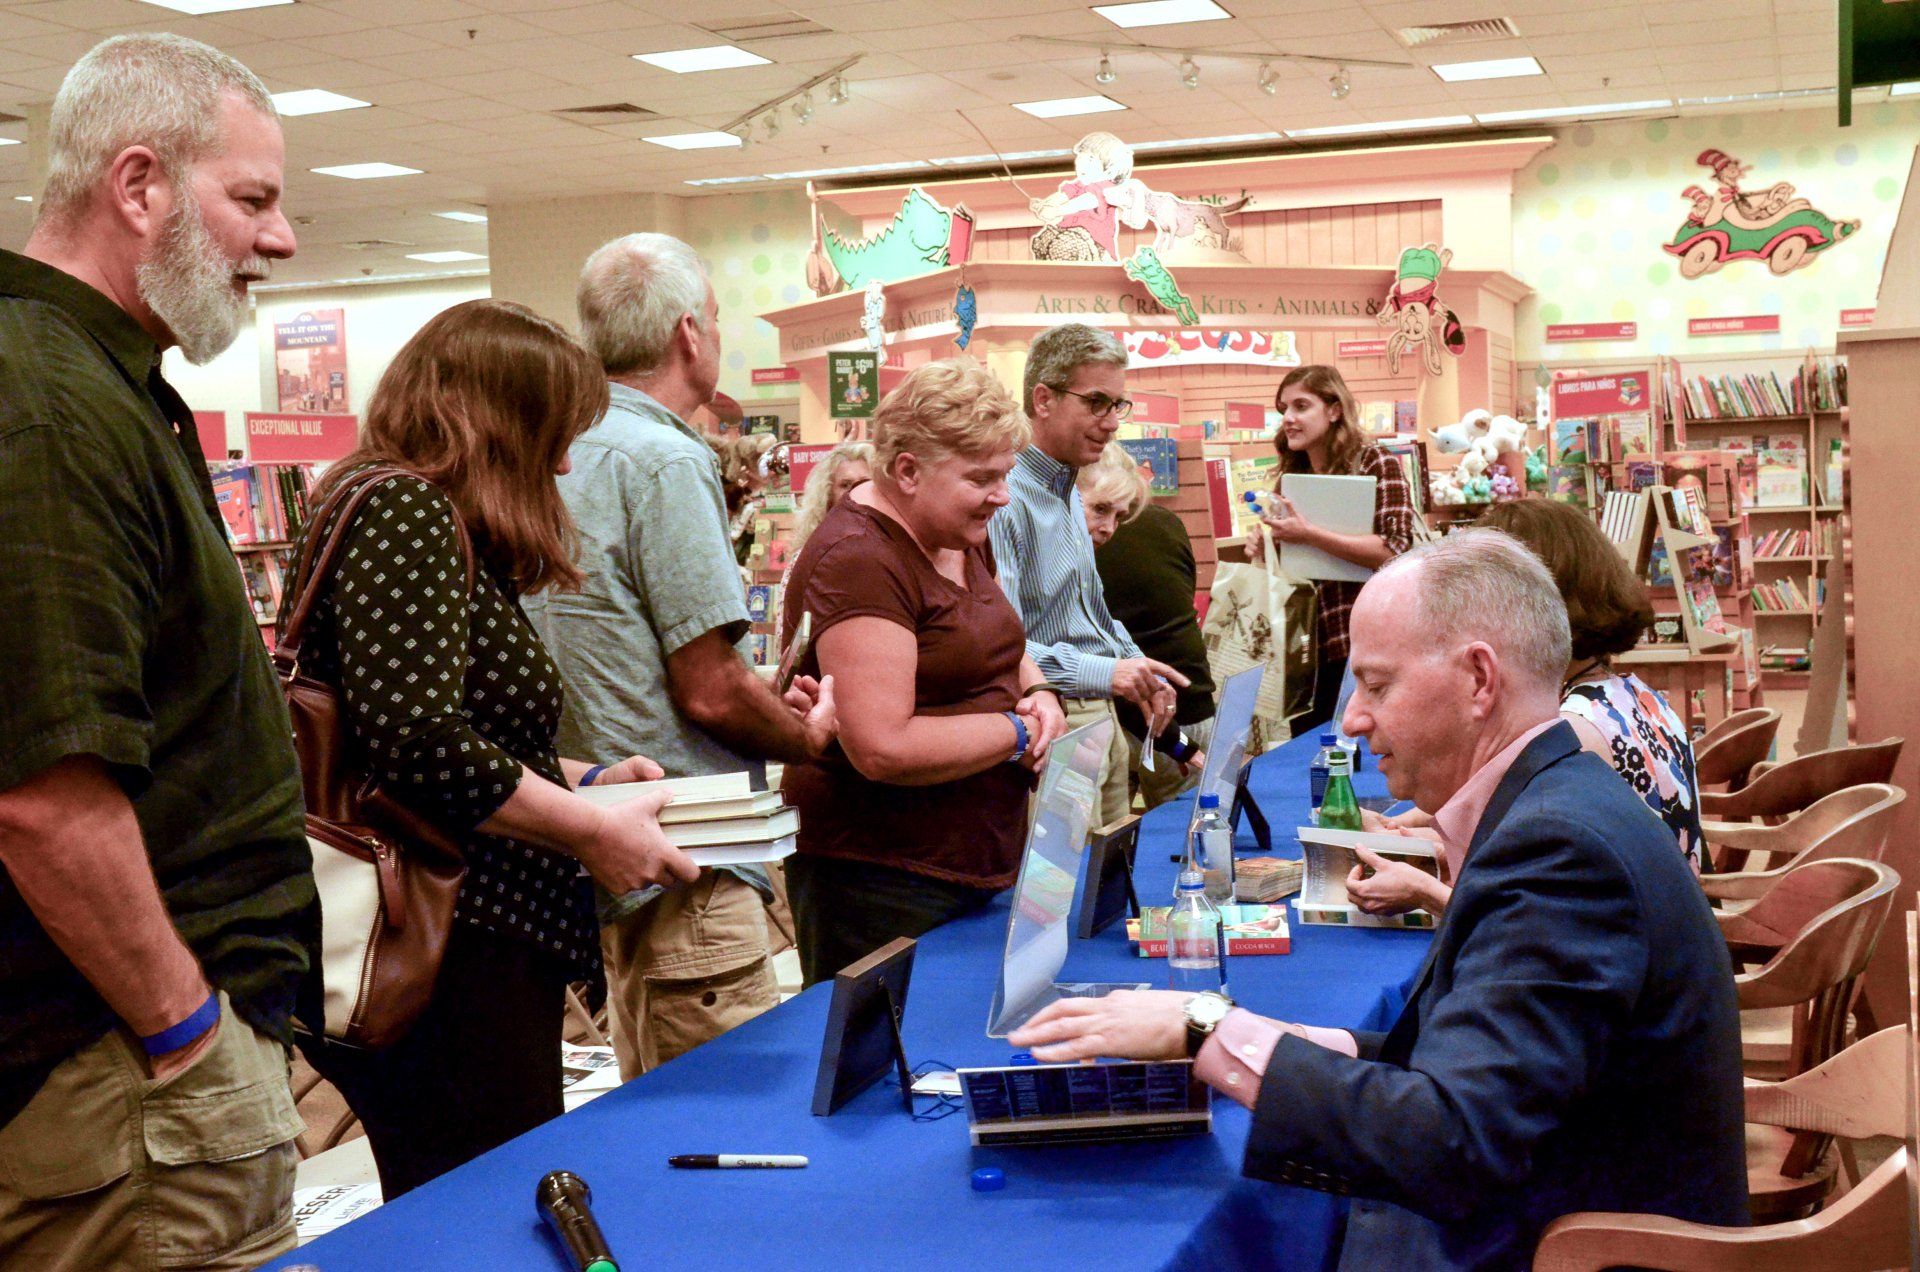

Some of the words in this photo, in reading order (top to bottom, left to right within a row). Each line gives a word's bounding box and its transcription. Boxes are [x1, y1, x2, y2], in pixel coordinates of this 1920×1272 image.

[1035, 293, 1087, 314] ARTS
[1092, 294, 1111, 314] &
[1118, 293, 1166, 315] CRA
[1201, 294, 1248, 316] KITS
[1273, 296, 1360, 316] ANIMALS
[907, 307, 947, 328] NATURE
[278, 327, 298, 335] TELL
[320, 324, 336, 332] THE
[287, 336, 328, 345] MOUNTAIN
[1558, 382, 1580, 394] LIBROS
[1580, 381, 1597, 391] PARA
[250, 419, 300, 435] EXCEPTIONAL
[300, 420, 323, 435] VALUE
